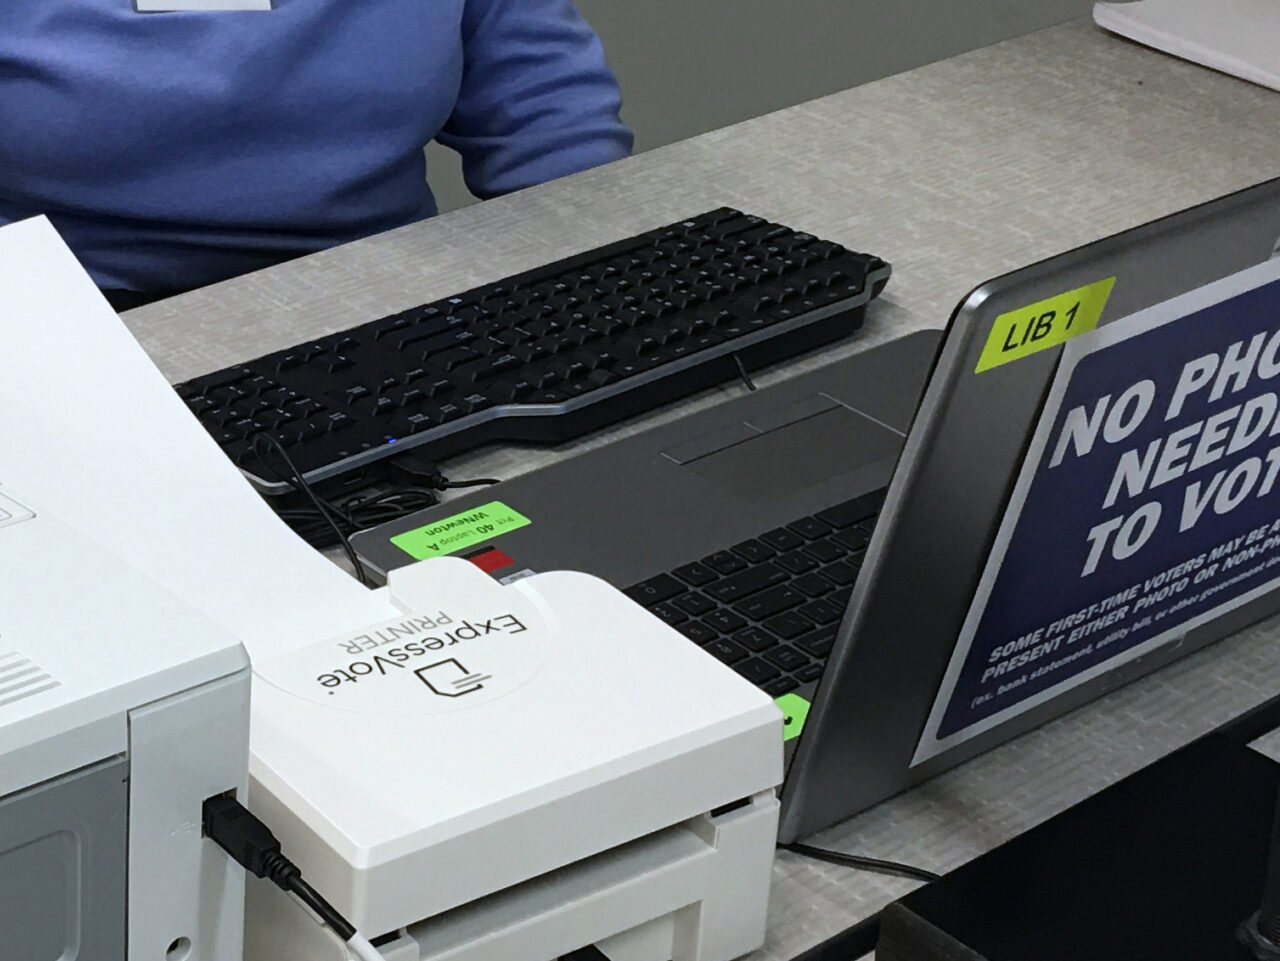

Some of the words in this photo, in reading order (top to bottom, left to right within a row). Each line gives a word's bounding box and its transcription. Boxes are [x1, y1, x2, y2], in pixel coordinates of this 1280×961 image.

[1002, 309, 1056, 353] LIB
[1064, 301, 1081, 331] 1
[1048, 379, 1156, 469] NO
[1102, 391, 1280, 510] NEED
[424, 510, 491, 536] WNewton
[426, 542, 440, 552] A
[439, 529, 475, 546] Laptop
[476, 523, 495, 535] 40
[1080, 501, 1162, 578] TO
[980, 634, 1065, 684] PRESENT
[1066, 605, 1130, 644] EITHER
[1132, 577, 1190, 614] PHOTO
[1193, 563, 1220, 584] OR
[988, 627, 1045, 663] SOME
[1045, 583, 1142, 639] FIRST-TIME
[1143, 553, 1207, 593] VOTERS
[1207, 534, 1246, 563] MAY
[1245, 523, 1270, 546] BE
[997, 674, 1028, 696] bank
[1155, 609, 1169, 621] or
[1169, 595, 1200, 614] other
[1199, 562, 1265, 602] government
[316, 613, 528, 688] ExpressVote
[337, 610, 454, 656] PRINTER
